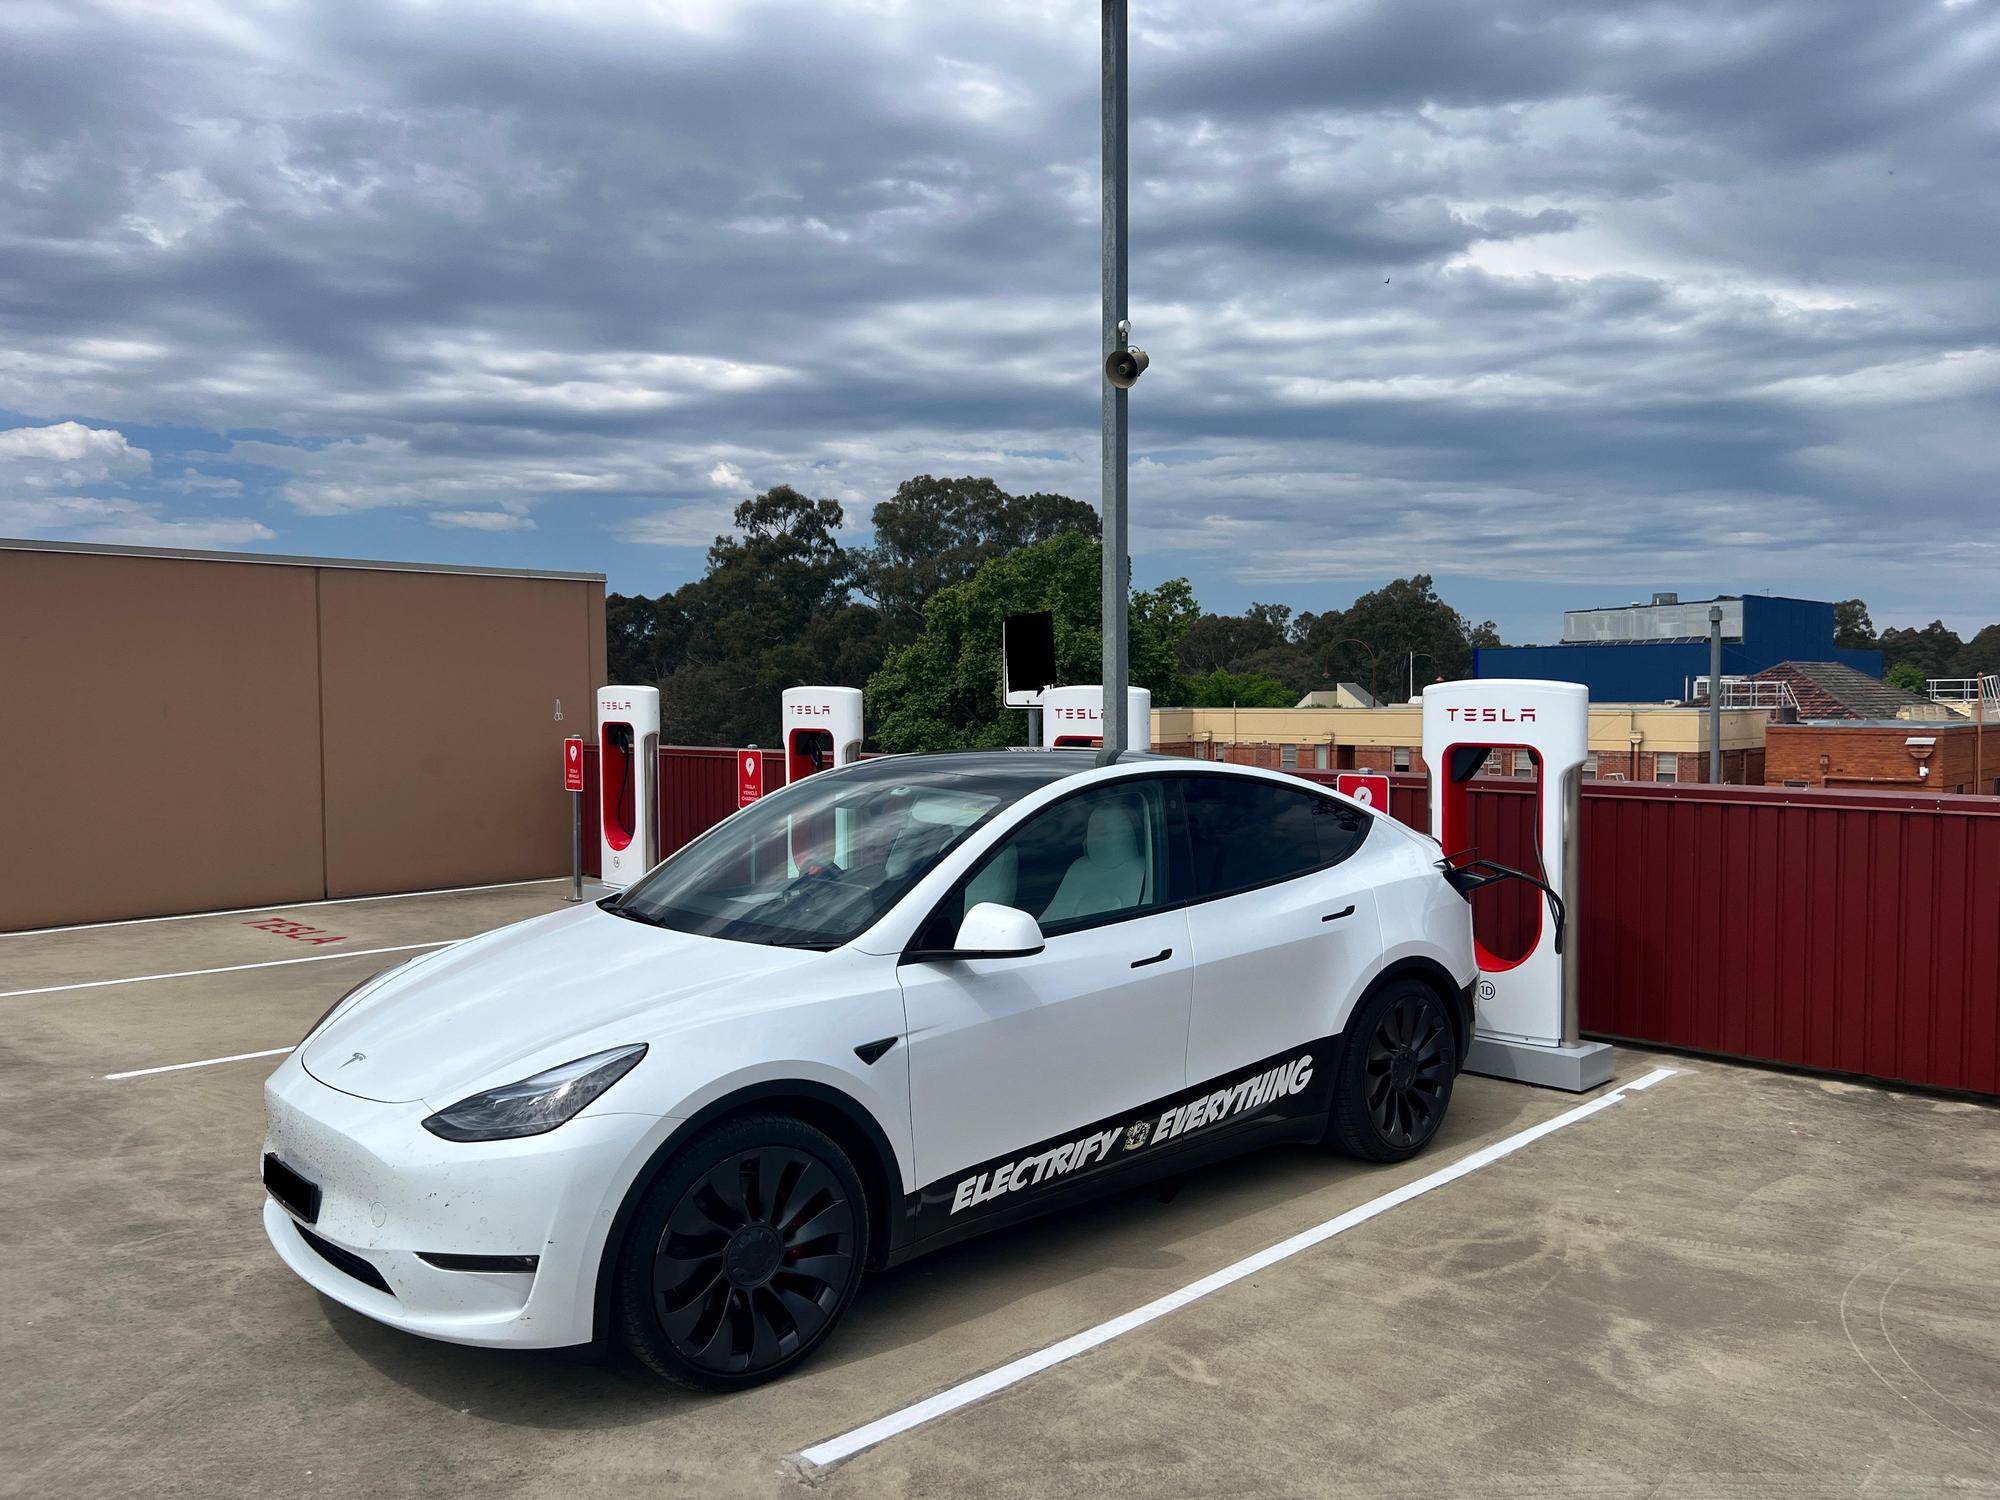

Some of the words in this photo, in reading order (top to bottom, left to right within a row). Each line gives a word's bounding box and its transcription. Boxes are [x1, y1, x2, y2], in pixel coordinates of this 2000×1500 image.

[601, 701, 632, 711] TESLA
[789, 705, 831, 715] TESLA
[1446, 708, 1536, 722] TESLA
[241, 918, 348, 945] TESLA
[1480, 985, 1494, 996] 1D
[950, 1126, 1124, 1216] ELECTRIFY
[1150, 1054, 1314, 1146] EVERYTHING
